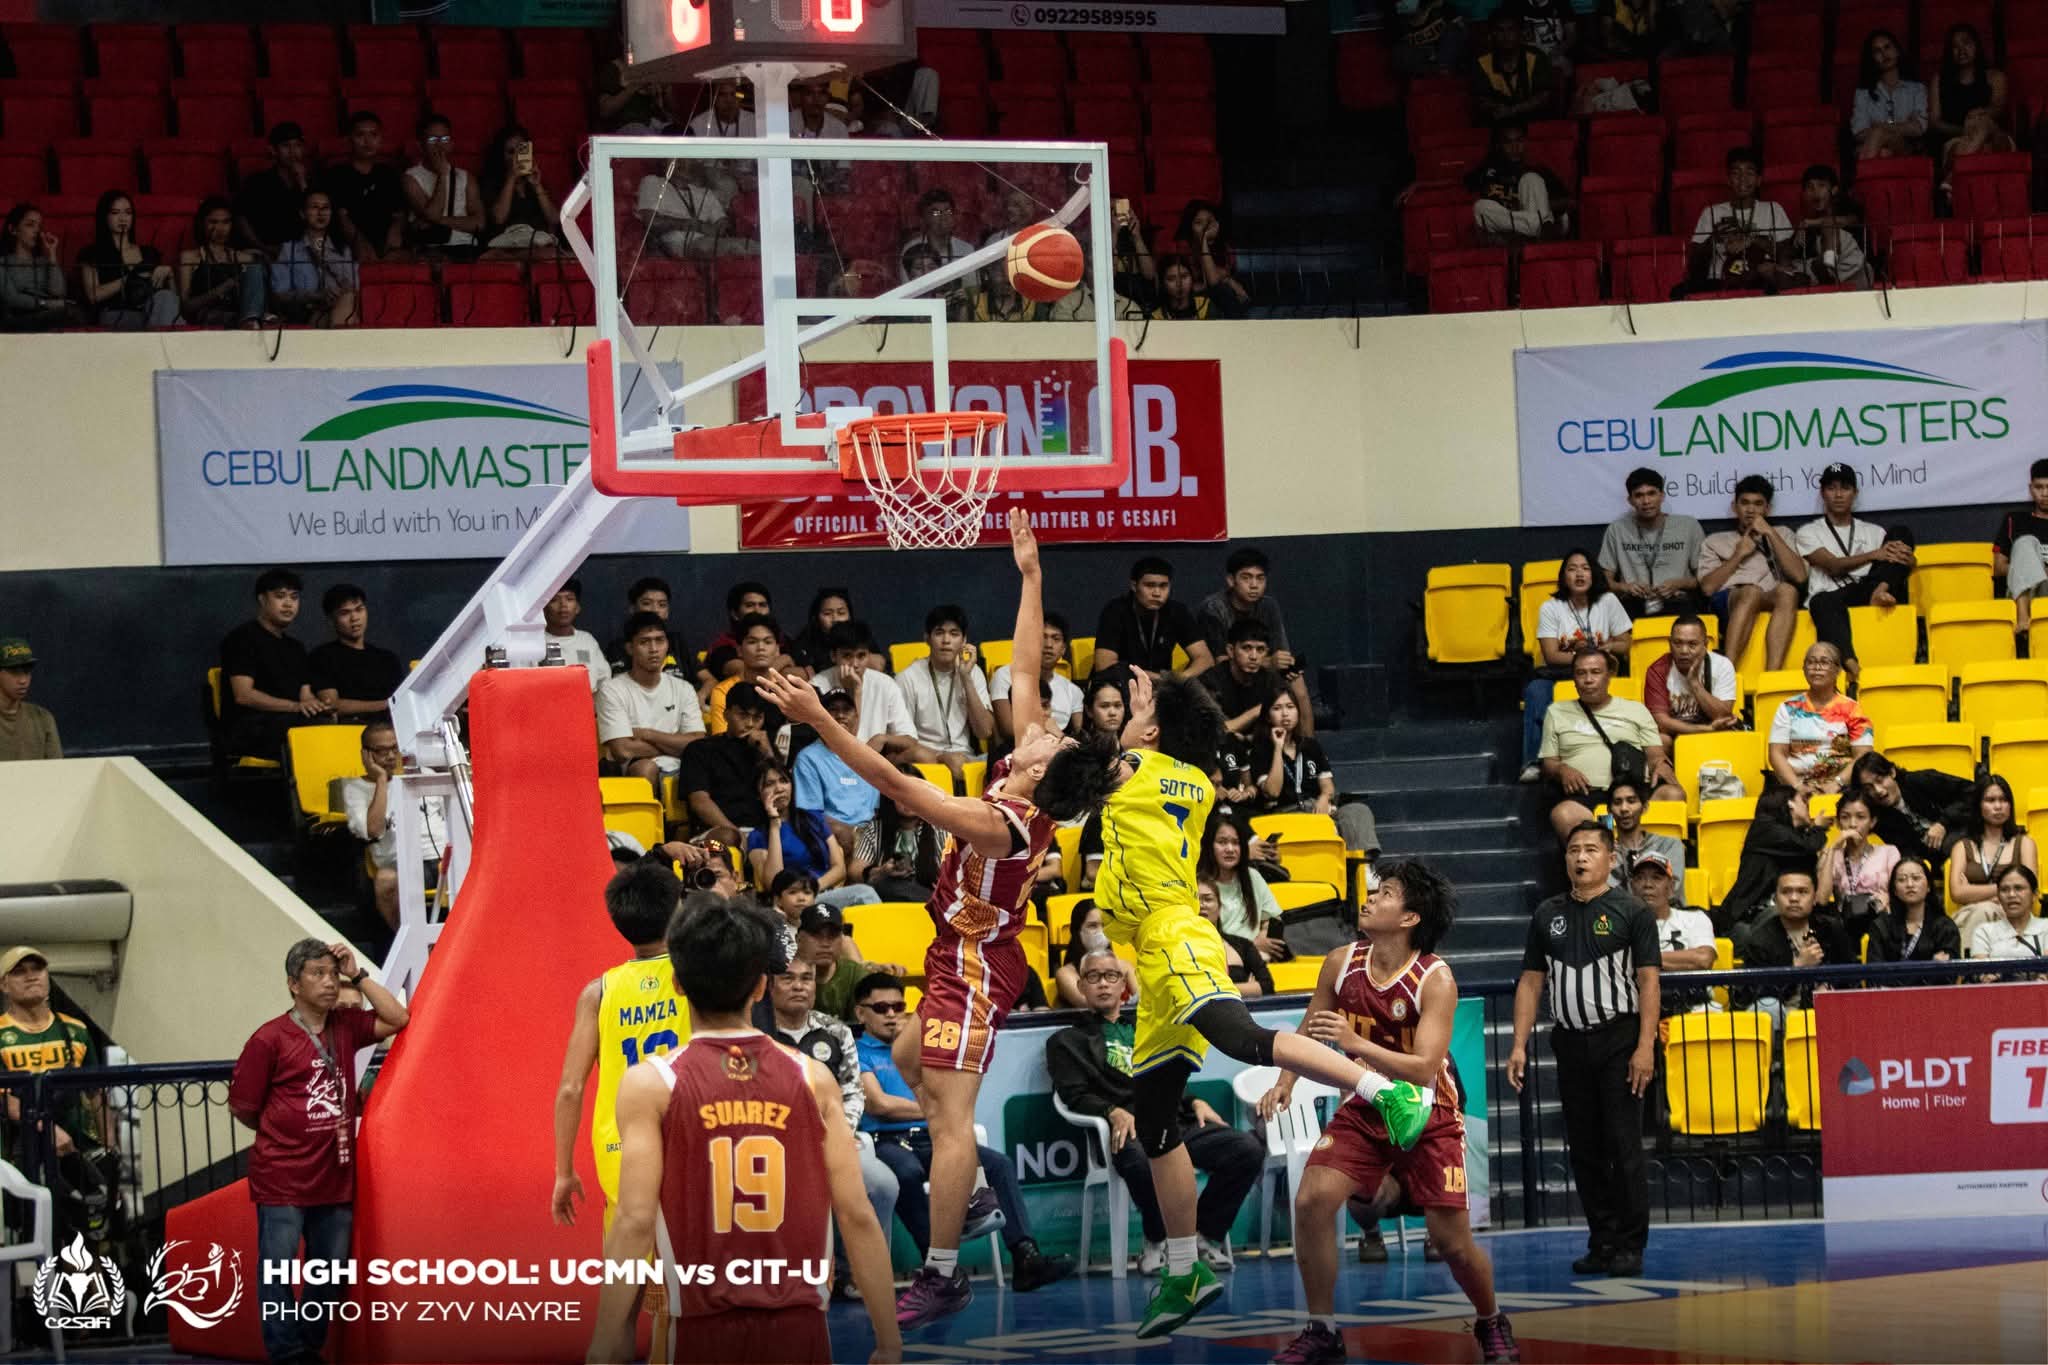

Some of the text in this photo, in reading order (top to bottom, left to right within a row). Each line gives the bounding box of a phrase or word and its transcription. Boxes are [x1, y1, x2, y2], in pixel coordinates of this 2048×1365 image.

[1034, 8, 1158, 26] 09229589595
[1556, 397, 2010, 457] CEBULANDMASTERS
[202, 444, 589, 492] CEBULANDMASTE
[1686, 470, 1738, 497] Build
[1801, 467, 1823, 491] Yo
[1871, 460, 1927, 486] Mind
[289, 508, 542, 537] We Build with You in Mi
[793, 515, 868, 533] OFFICIAL
[1030, 511, 1089, 529] ARTNER
[1096, 511, 1115, 527] OF
[1122, 509, 1177, 527] CESAFI
[1662, 542, 1685, 551] SHOT
[1160, 778, 1204, 803] SOTTO
[1162, 801, 1190, 858] 7
[620, 998, 678, 1027] MAMZA
[924, 1018, 961, 1050] 28
[1880, 1056, 1973, 1089] PLDT
[699, 1100, 792, 1131] SUAREZ
[1882, 1095, 1967, 1110] Home Fiber
[1016, 1140, 1080, 1180] NO
[709, 1135, 786, 1234] 19
